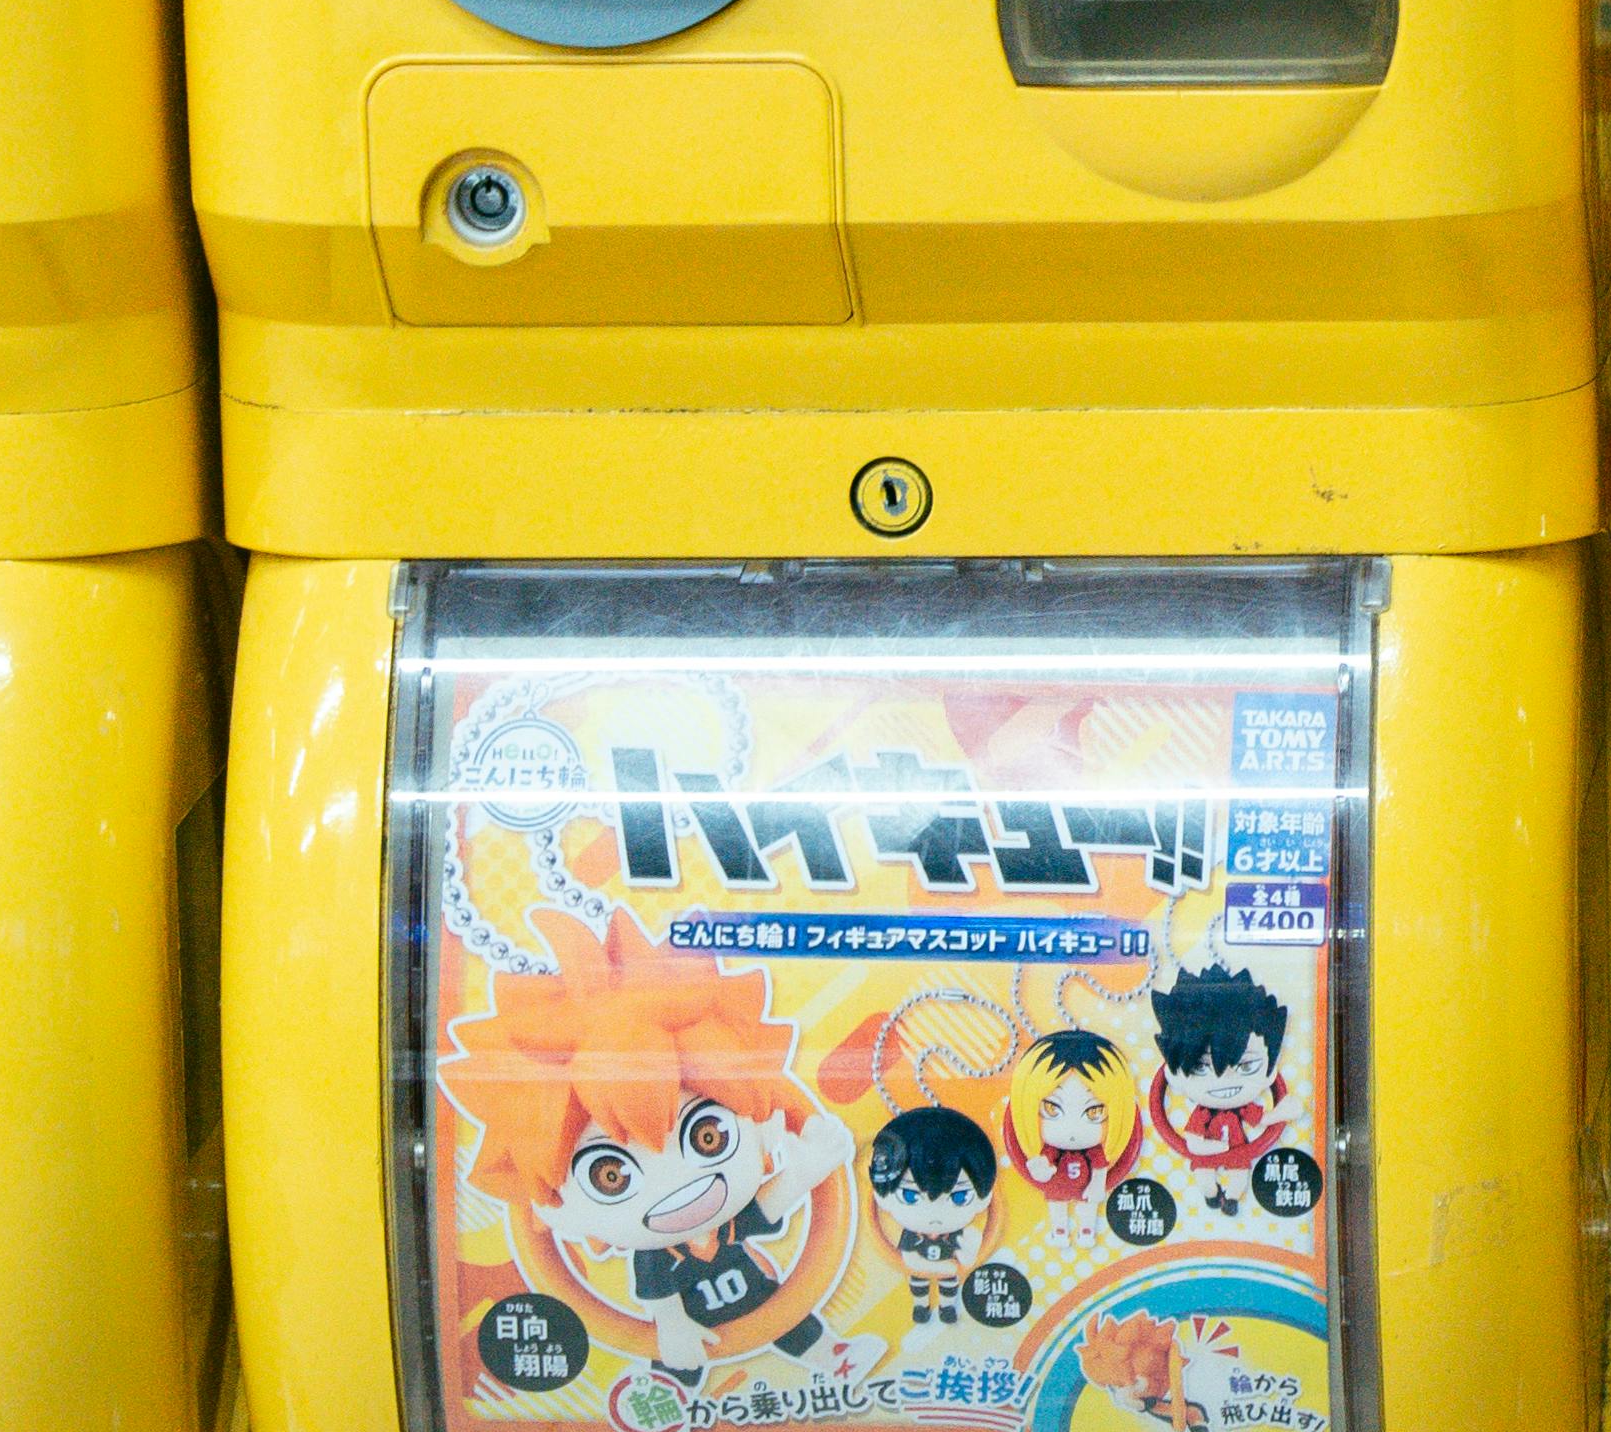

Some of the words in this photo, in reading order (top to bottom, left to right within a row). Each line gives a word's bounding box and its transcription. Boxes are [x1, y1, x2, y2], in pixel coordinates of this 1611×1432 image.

[1241, 709, 1327, 727] TAKARA
[1240, 728, 1326, 749] TOMY
[1234, 811, 1325, 836] 対象年齢
[495, 1314, 549, 1342] 日向
[513, 1352, 569, 1380] 翔陽
